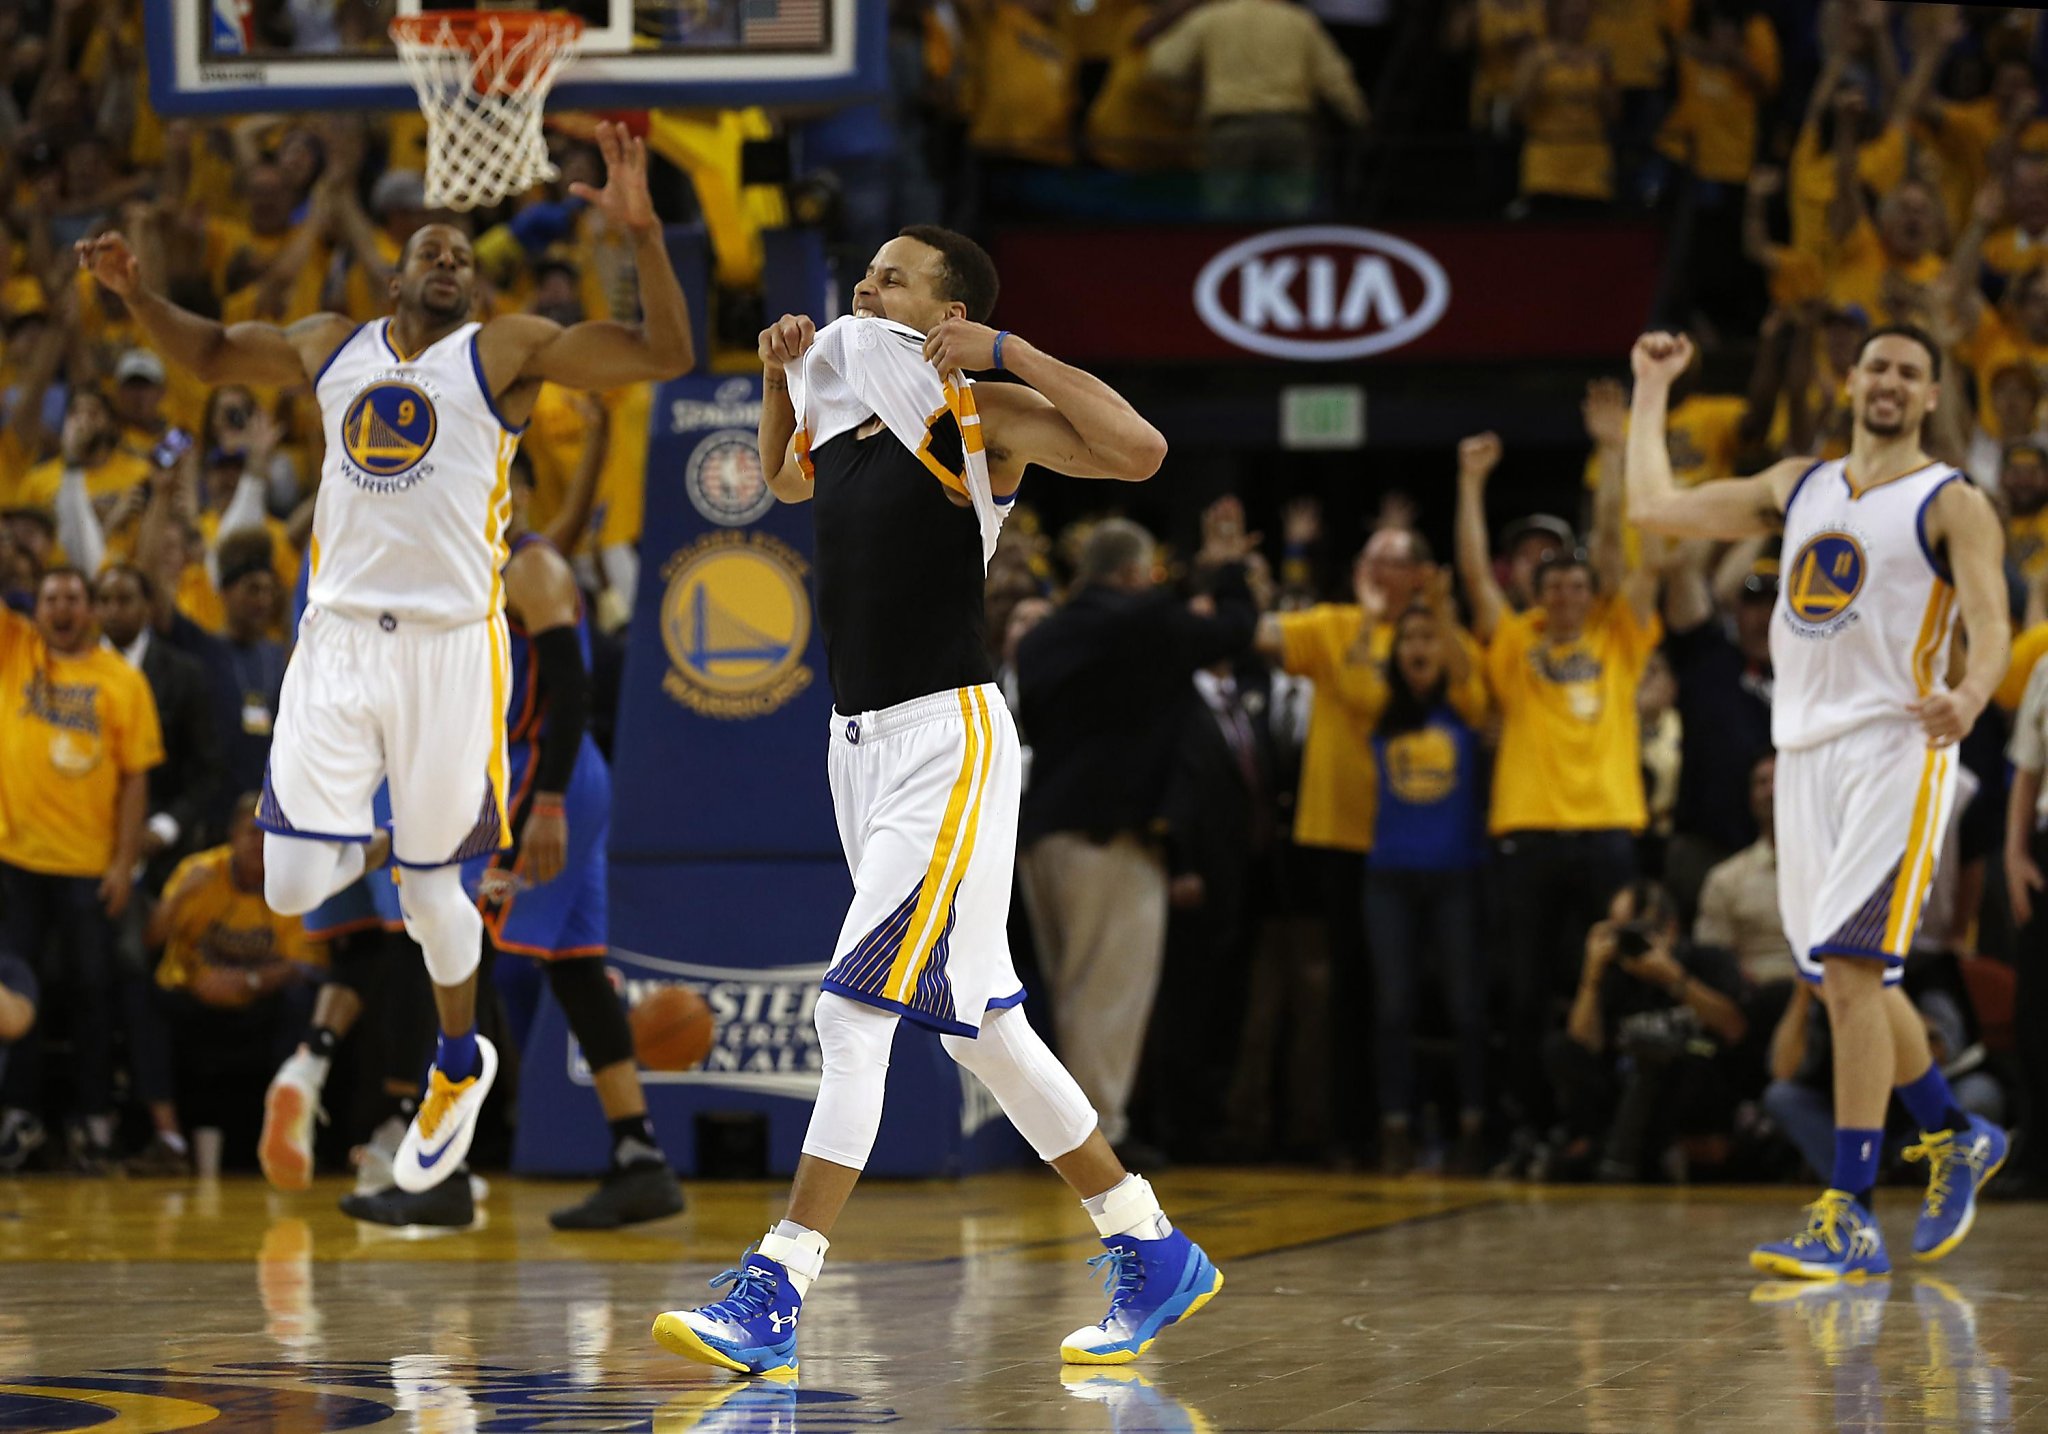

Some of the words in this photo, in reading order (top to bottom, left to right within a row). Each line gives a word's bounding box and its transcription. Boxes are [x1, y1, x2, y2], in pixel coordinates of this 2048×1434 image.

[1241, 256, 1404, 329] KIA
[398, 399, 416, 427] 9
[341, 458, 434, 494] WARRIORS
[846, 726, 858, 741] W
